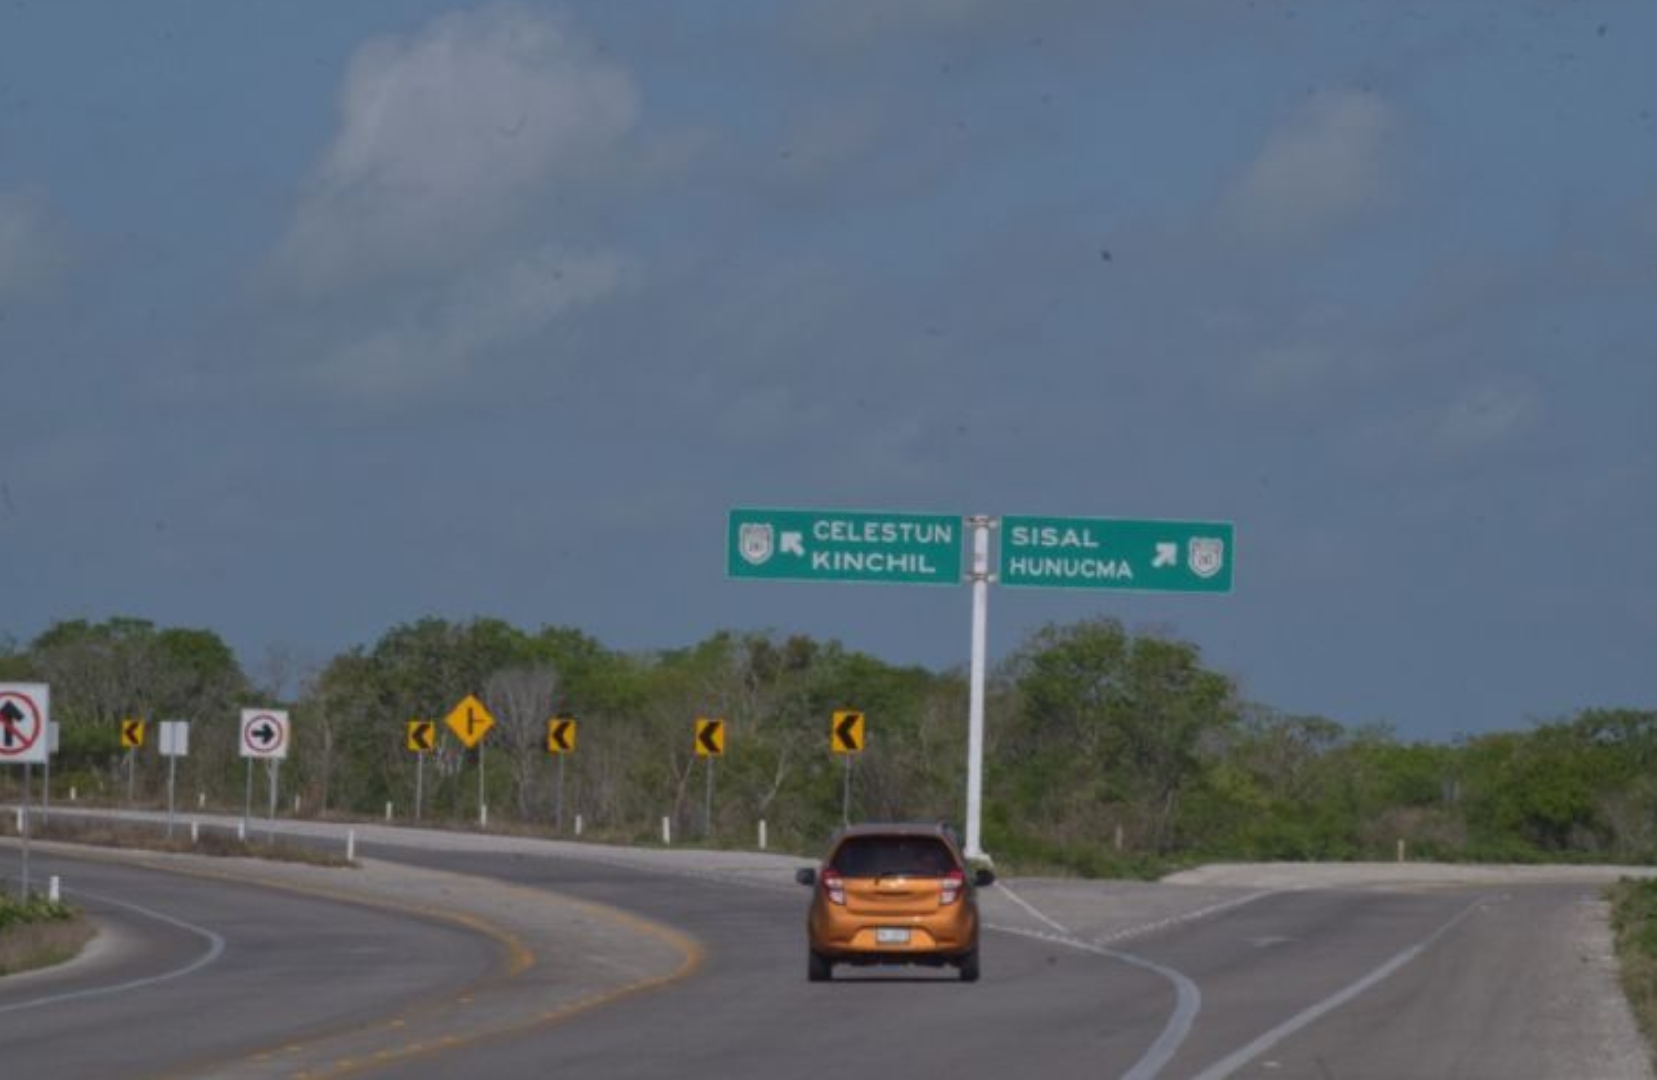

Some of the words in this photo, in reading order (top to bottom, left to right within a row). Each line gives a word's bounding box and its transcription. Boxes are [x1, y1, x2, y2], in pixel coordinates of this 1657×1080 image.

[813, 520, 953, 543] CELESTUN
[1011, 527, 1099, 548] SISAL
[812, 550, 936, 574] KINCHIL
[1010, 557, 1133, 580] HUNUCMA
